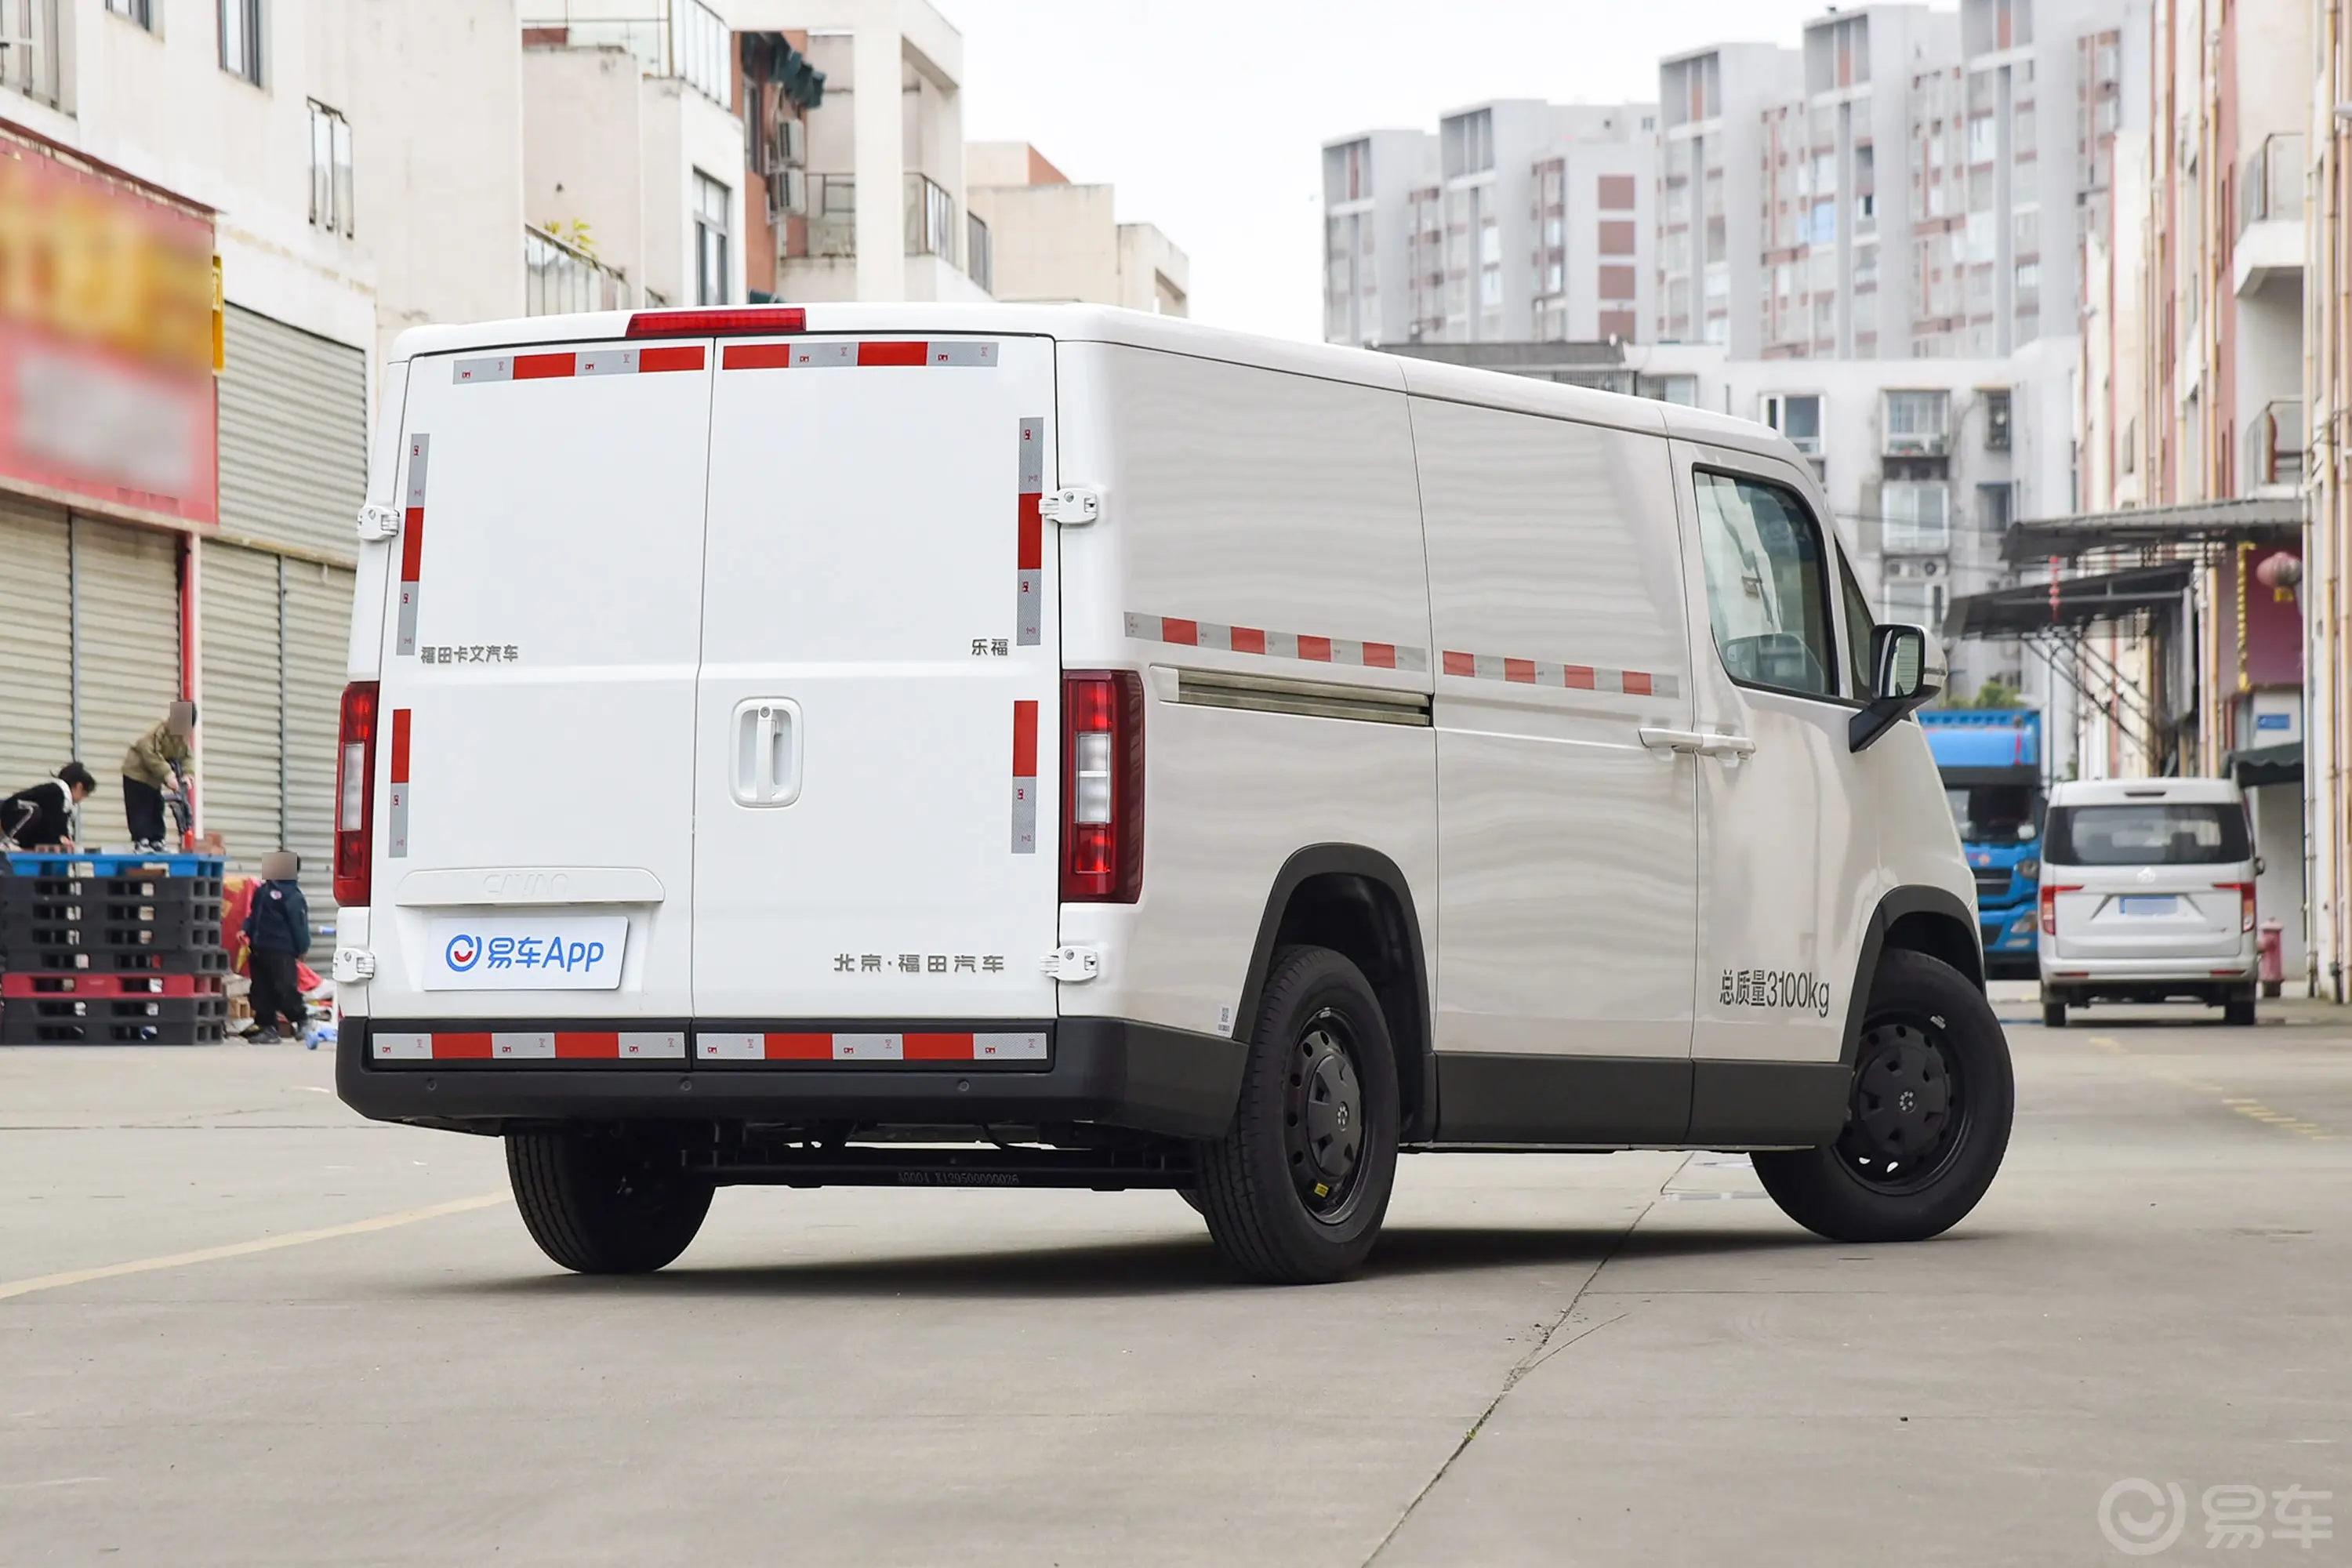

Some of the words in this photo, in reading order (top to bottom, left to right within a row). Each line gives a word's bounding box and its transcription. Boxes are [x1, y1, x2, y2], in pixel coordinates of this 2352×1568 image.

[420, 644, 518, 664] 福田卡文汽车
[971, 638, 1008, 656] 乐福
[487, 936, 604, 972] 易车App
[833, 953, 1004, 973] 北京·福田汽车
[1719, 968, 1830, 1018] 总质量3100kg
